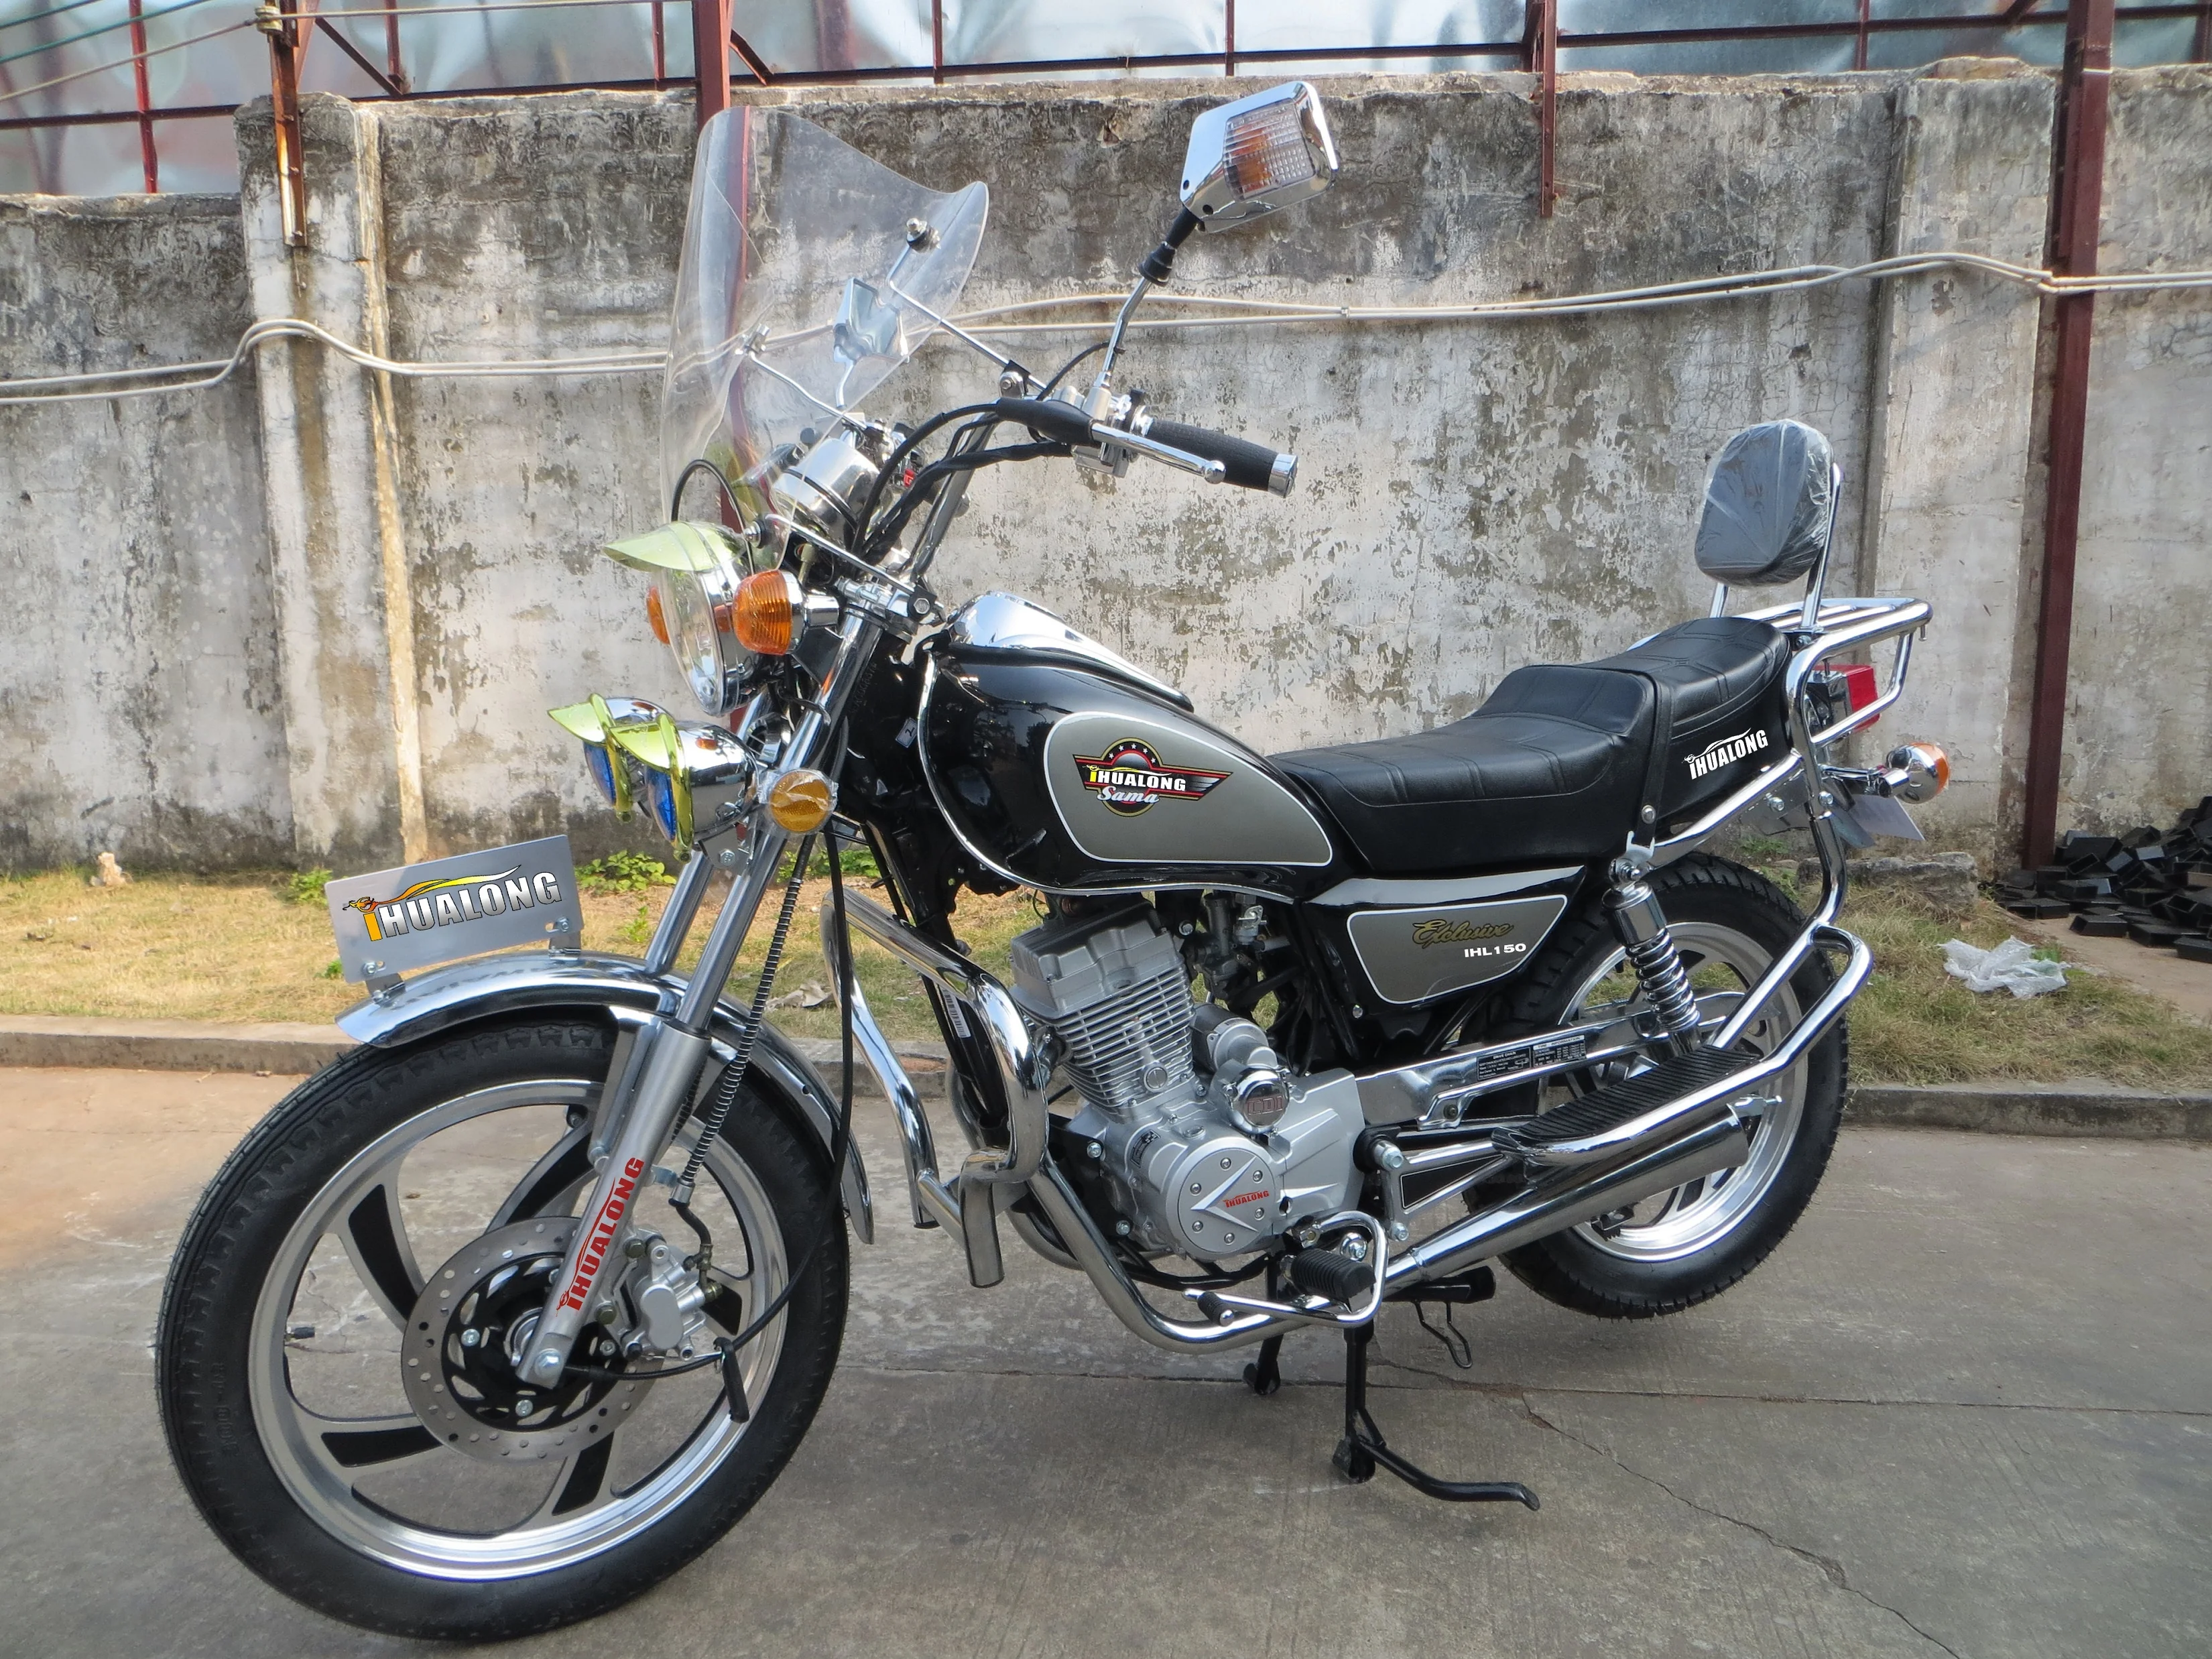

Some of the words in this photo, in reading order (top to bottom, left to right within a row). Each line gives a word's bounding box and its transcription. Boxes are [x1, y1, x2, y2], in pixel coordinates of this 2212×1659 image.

[1097, 786, 1160, 804] Sama
[1412, 918, 1514, 949] Exclusive
[1464, 942, 1527, 958] IHL150
[1247, 1095, 1284, 1115] CDI
